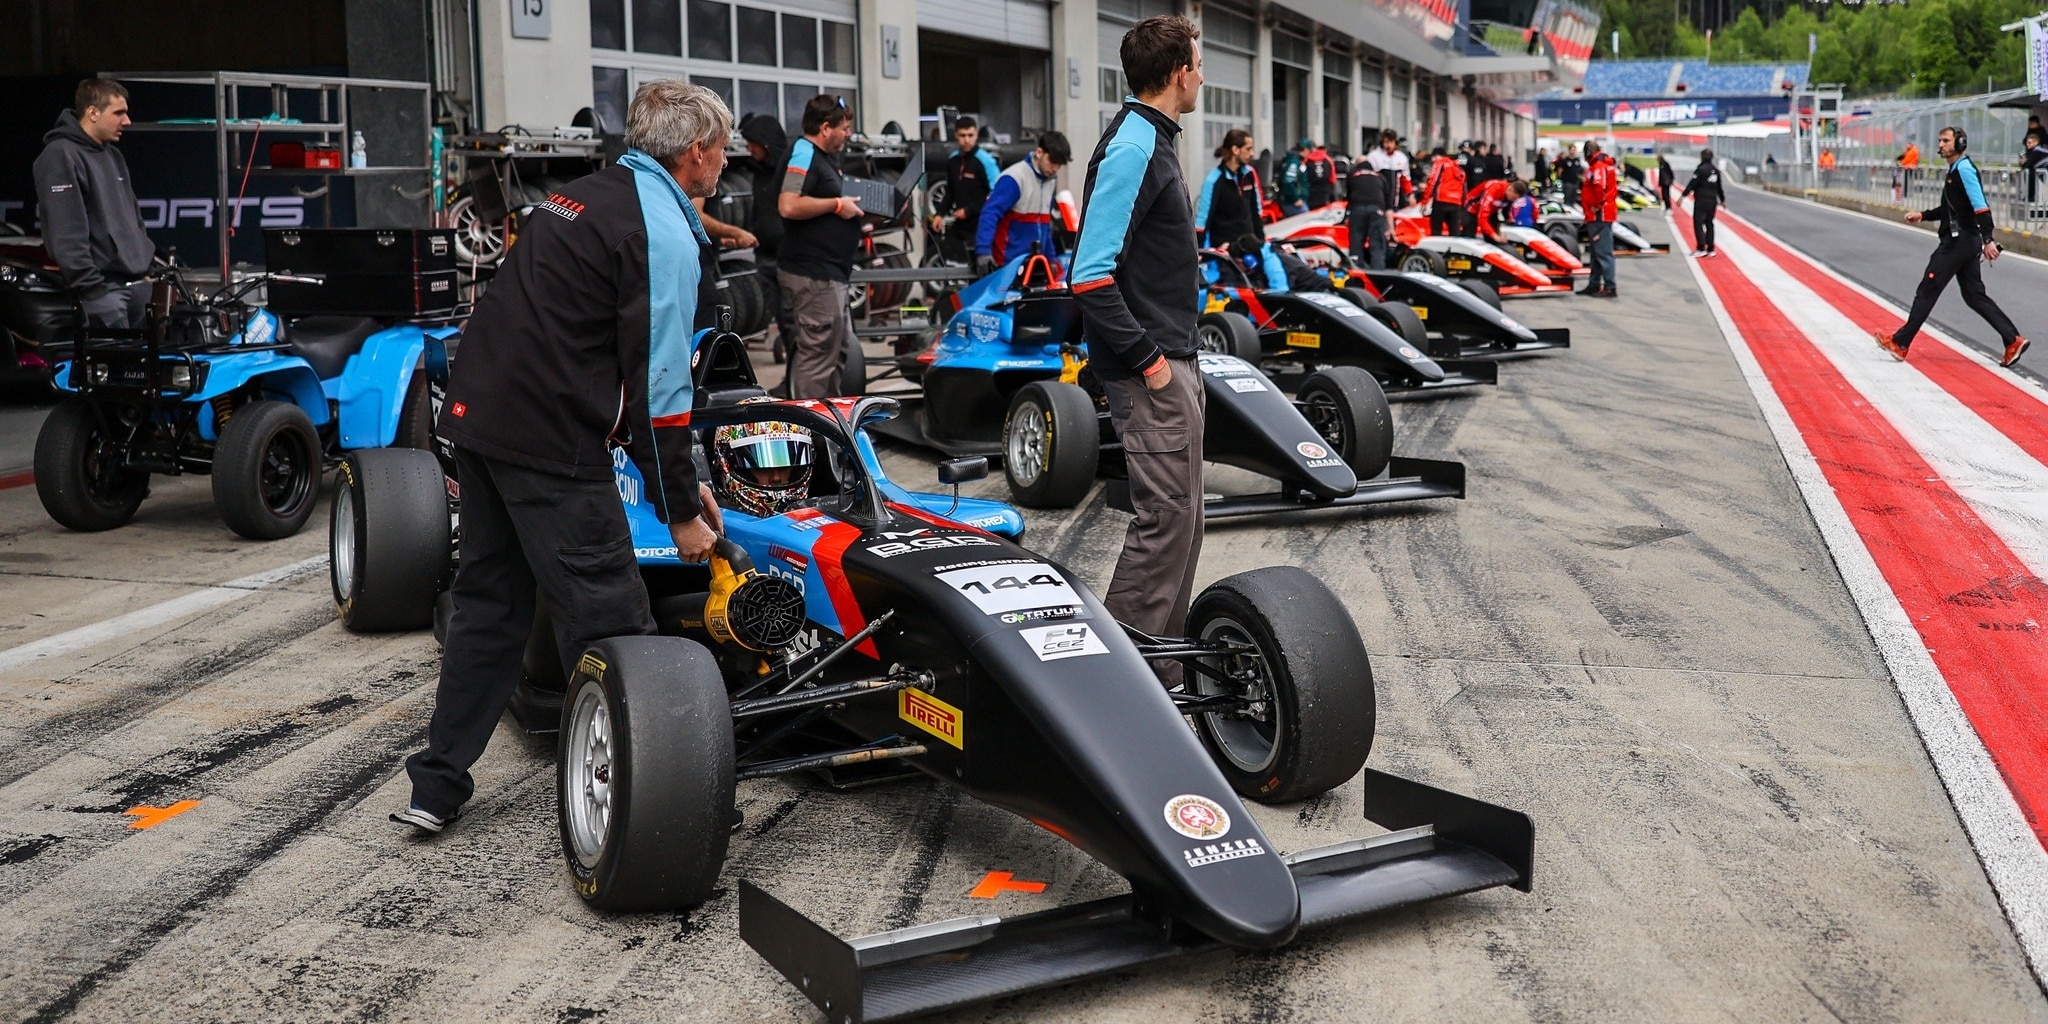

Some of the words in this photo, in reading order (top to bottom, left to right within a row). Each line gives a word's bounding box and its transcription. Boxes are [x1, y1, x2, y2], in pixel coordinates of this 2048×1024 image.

[1612, 103, 1697, 122] BULLETIN
[866, 535, 990, 557] BGR
[961, 574, 1065, 595] 144
[1022, 607, 1084, 619] TATUUS
[1043, 639, 1085, 650] CEZ
[1044, 627, 1087, 644] F4
[905, 691, 955, 738] PIRELLI
[1183, 838, 1259, 860] JENZER
